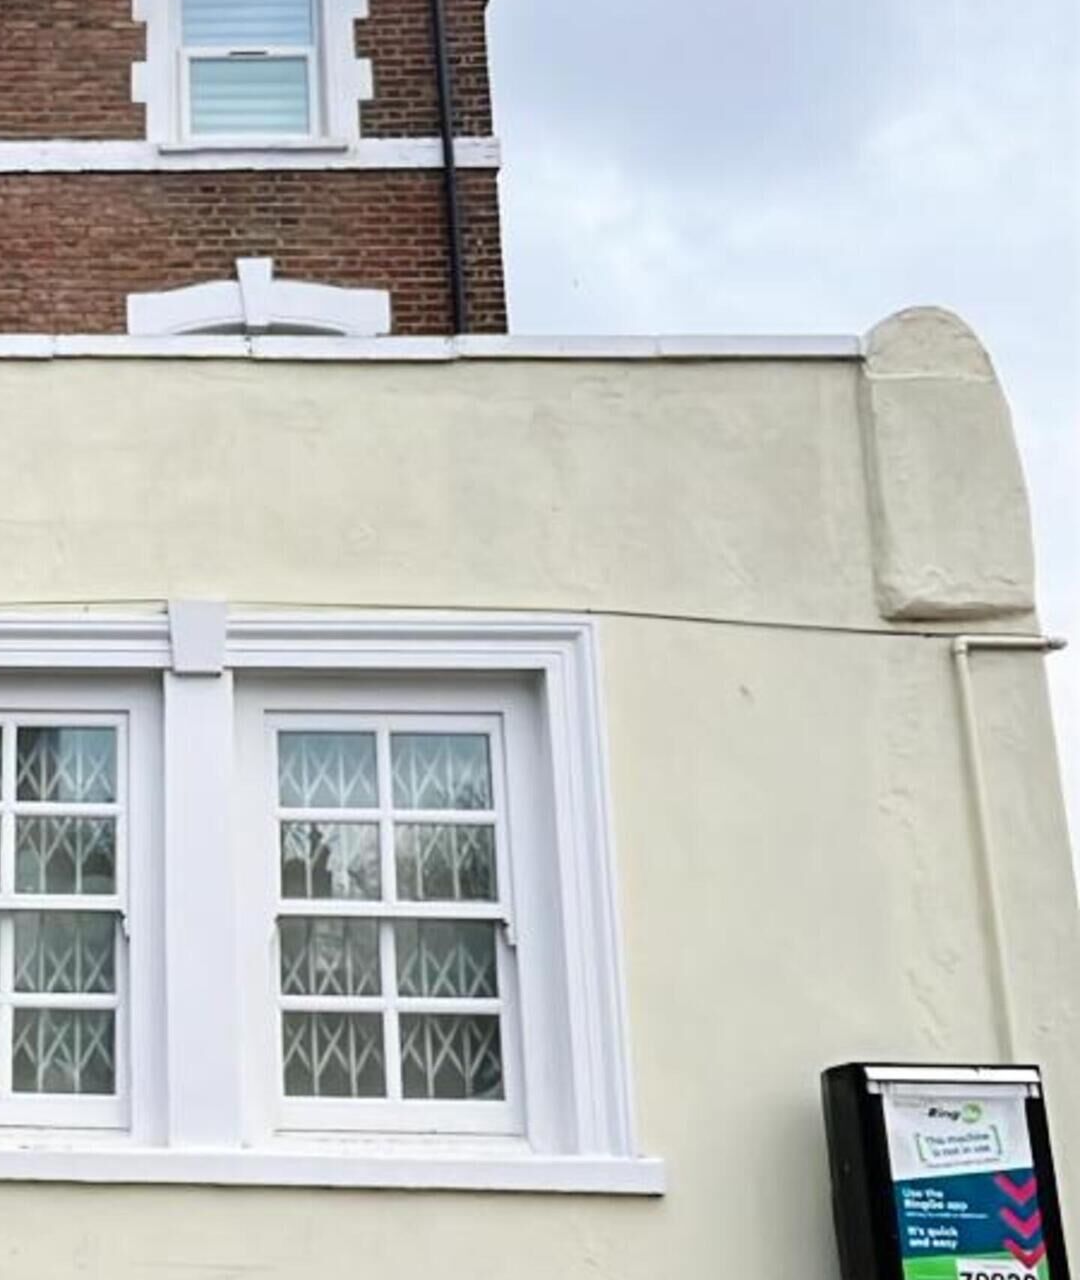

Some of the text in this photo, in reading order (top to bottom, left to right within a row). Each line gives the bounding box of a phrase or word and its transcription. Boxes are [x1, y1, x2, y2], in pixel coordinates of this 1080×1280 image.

[902, 1187, 944, 1198] Use the
[907, 1225, 958, 1238] It's quick
[909, 1237, 958, 1250] and easy
